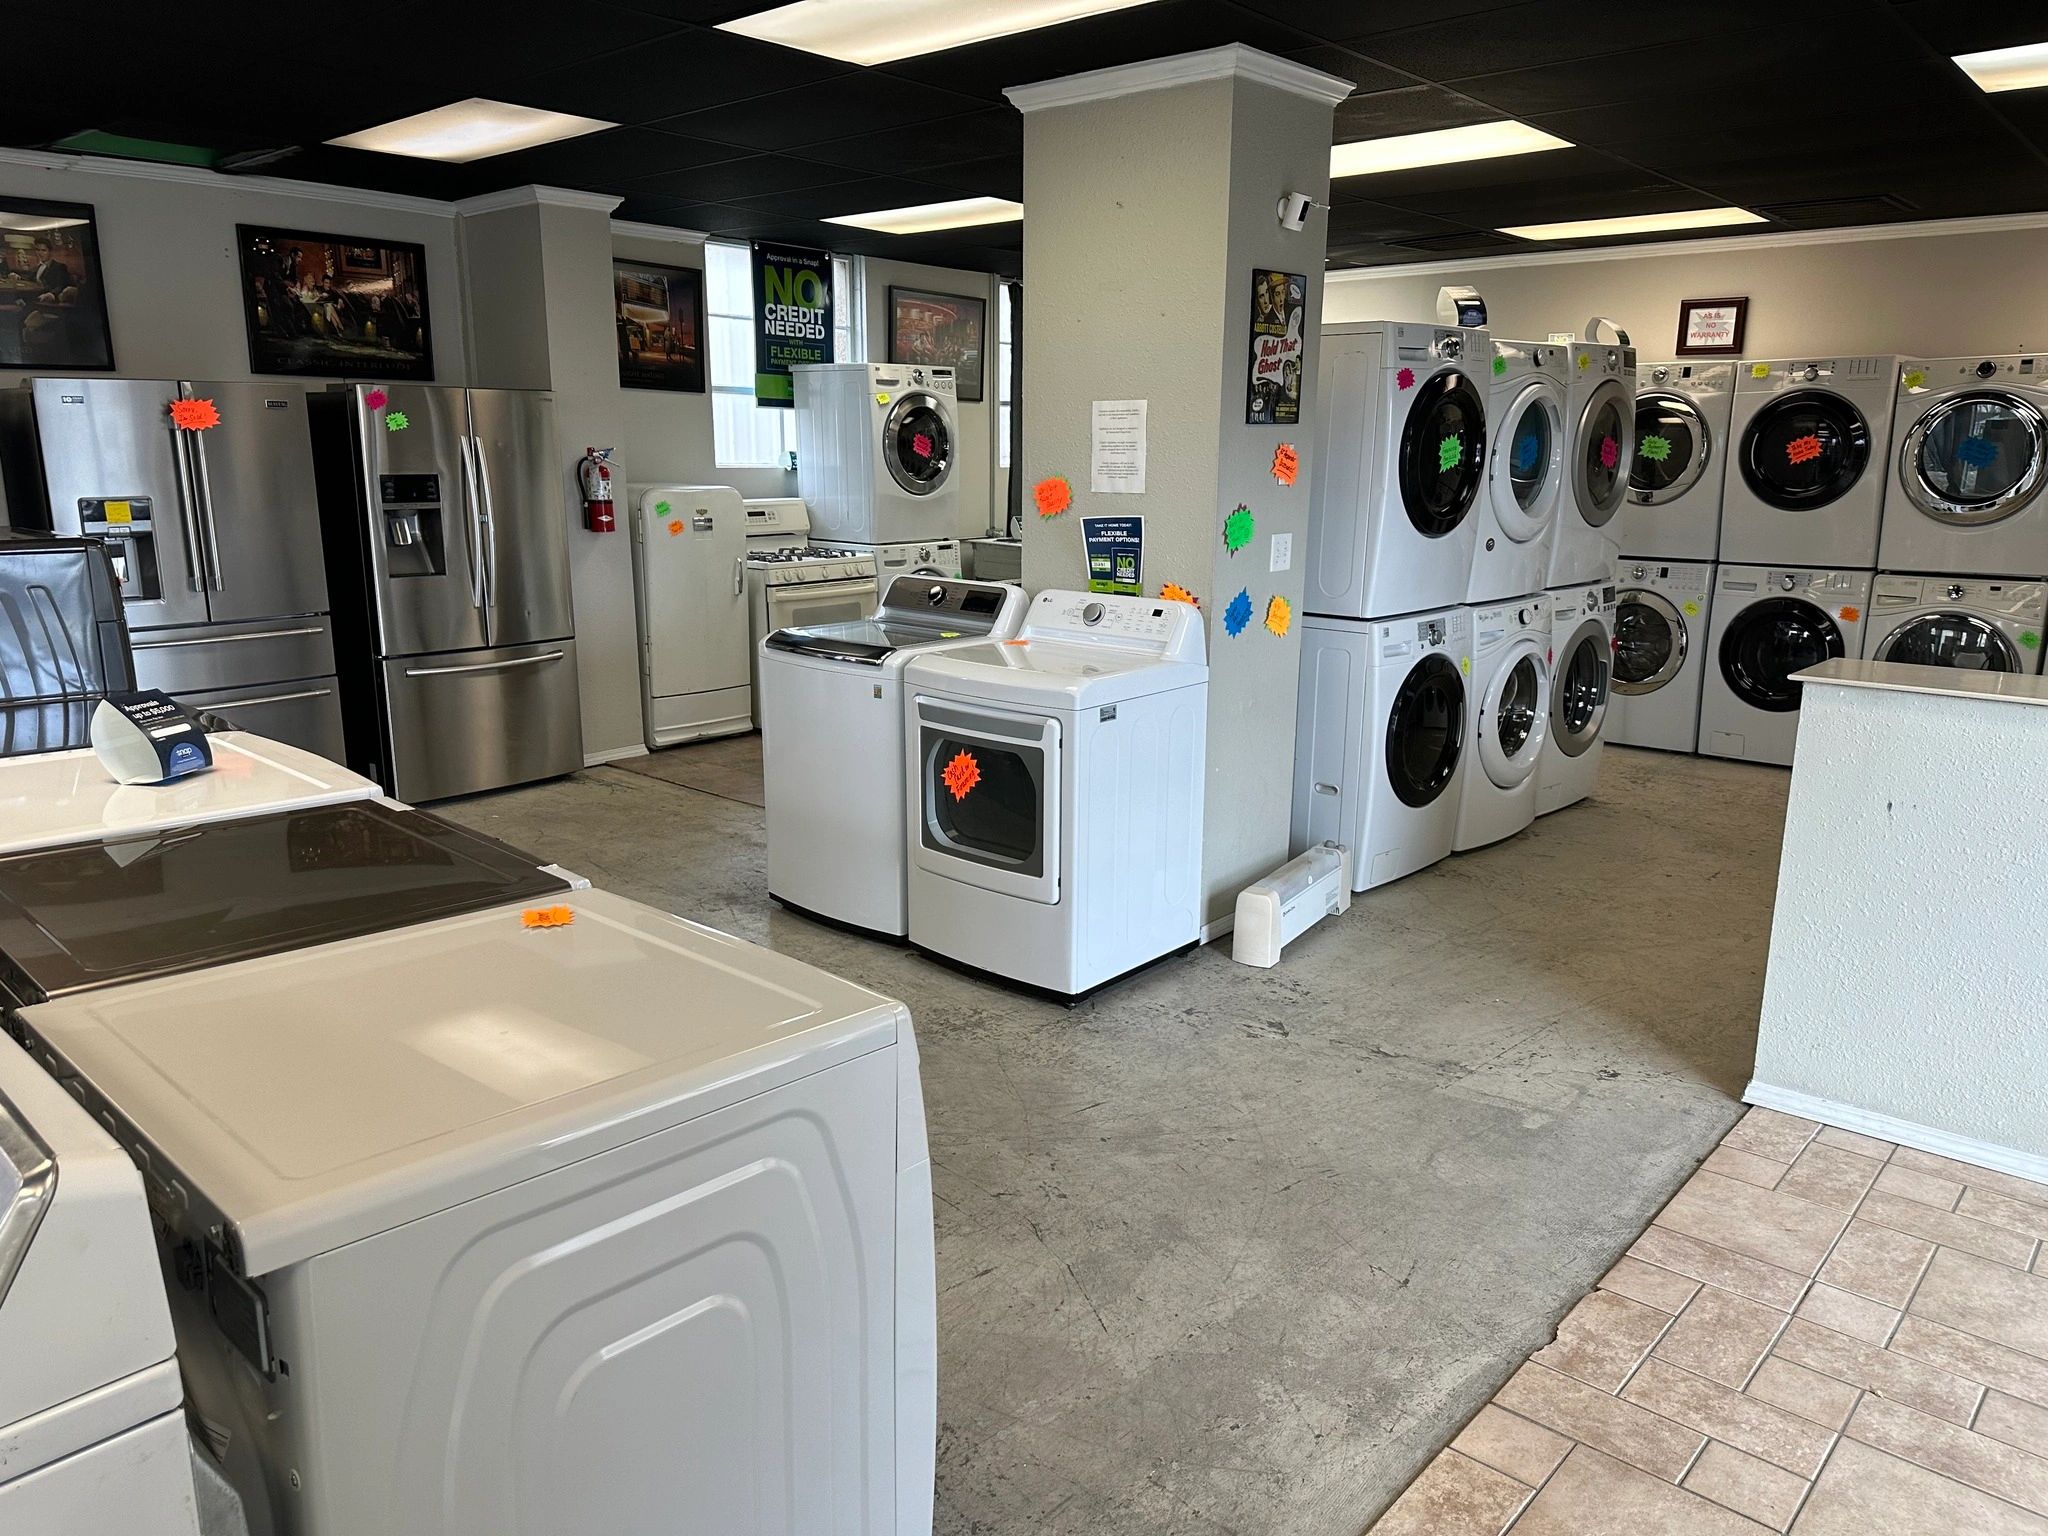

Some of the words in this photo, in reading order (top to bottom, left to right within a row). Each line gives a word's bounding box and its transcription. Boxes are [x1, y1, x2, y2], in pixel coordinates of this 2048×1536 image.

[766, 252, 791, 263] Approval
[803, 258, 819, 267] Snap!
[764, 264, 823, 308] NO
[764, 302, 825, 325] CREDIT
[1703, 311, 1713, 319] AS
[1714, 311, 1721, 319] IS
[764, 319, 825, 340] NEEDED
[1690, 330, 1729, 339] WARRANTY
[770, 345, 822, 361] FLEXIBLE
[1260, 339, 1280, 358] Hold
[1279, 338, 1298, 353] That
[1257, 357, 1283, 375] Ghost
[1116, 556, 1135, 569] NO
[124, 699, 160, 712] Approvals
[132, 711, 143, 720] up
[142, 708, 152, 717] to
